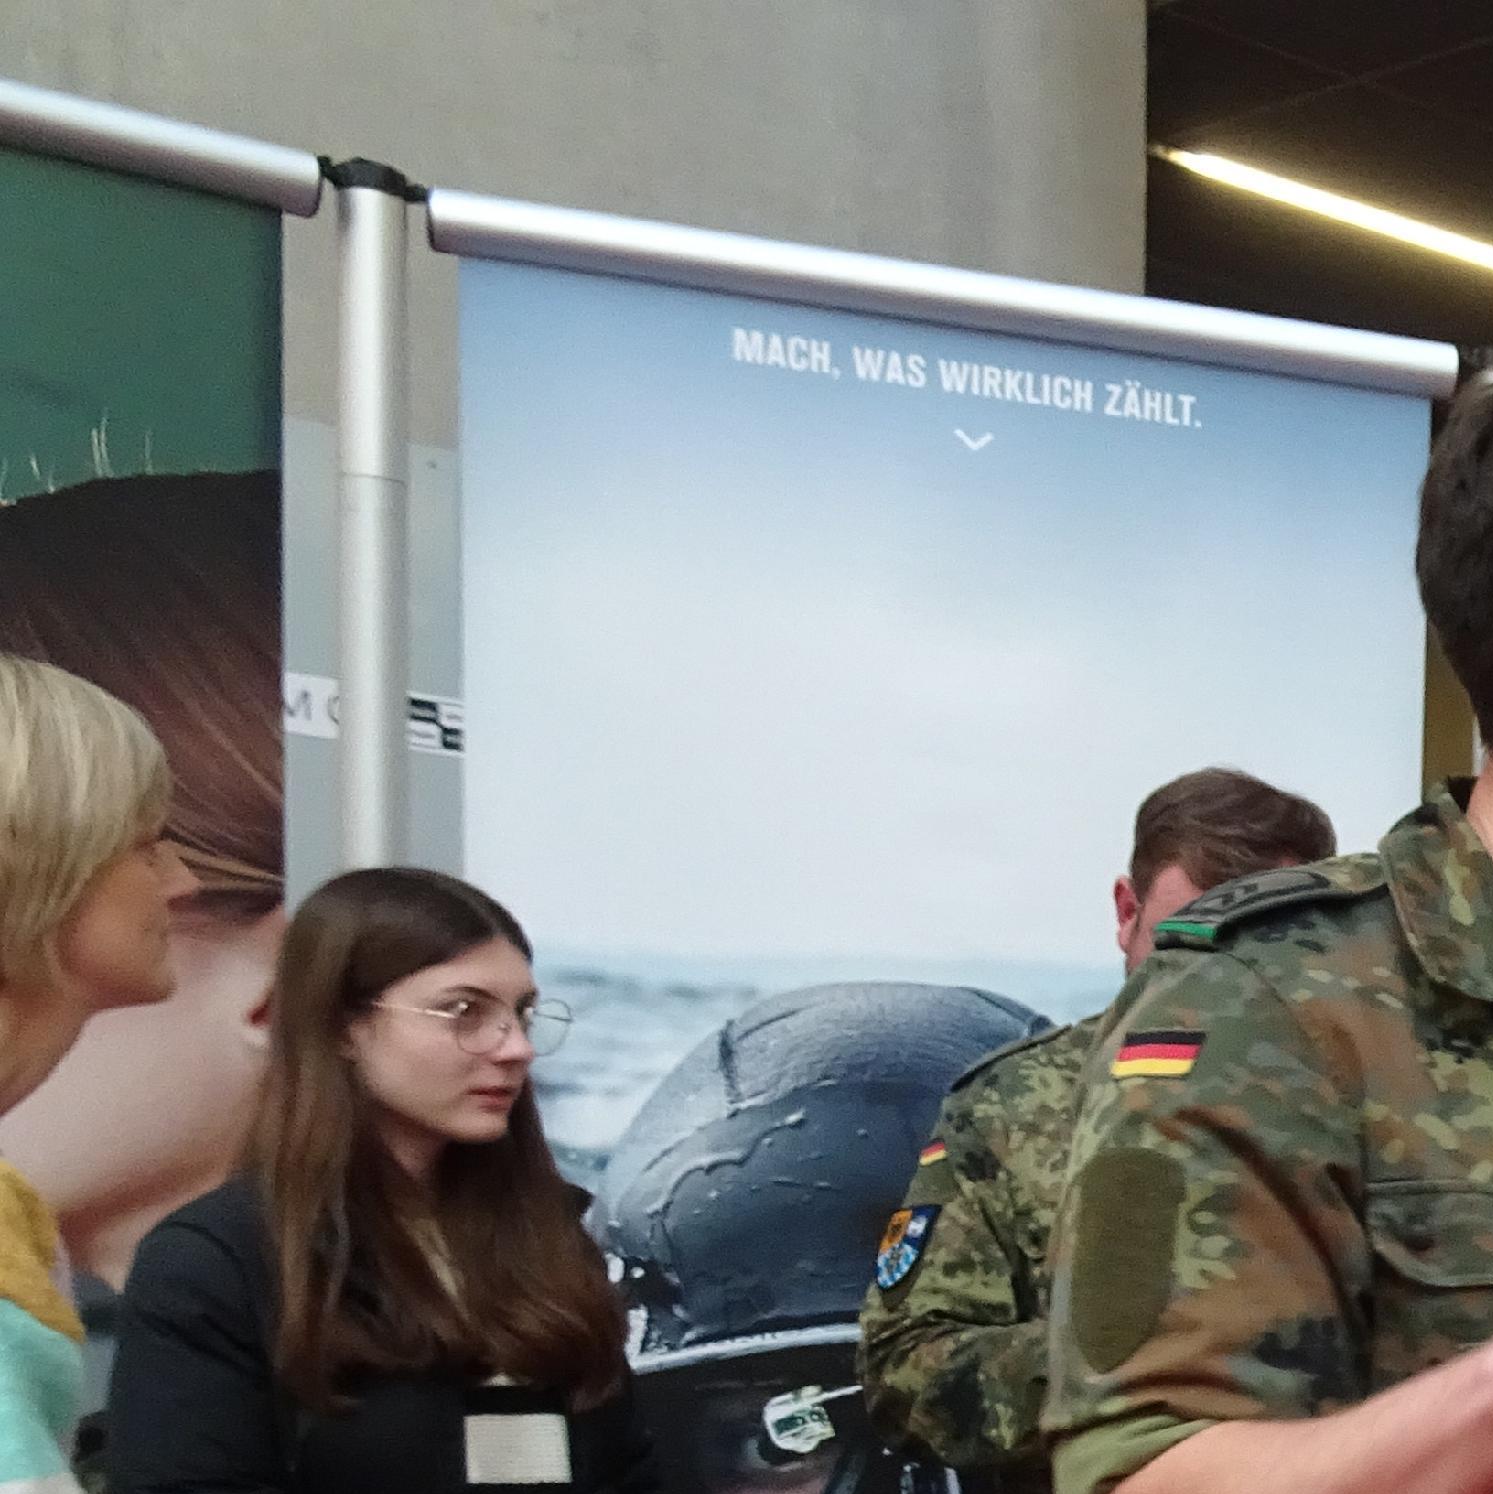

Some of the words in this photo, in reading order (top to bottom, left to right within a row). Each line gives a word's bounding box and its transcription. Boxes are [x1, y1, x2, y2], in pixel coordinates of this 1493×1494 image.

[731, 327, 841, 380] MACH,
[851, 345, 927, 388] WAS
[936, 358, 1093, 413] WIRKLICH
[1103, 379, 1202, 428] ZÄHLT.
